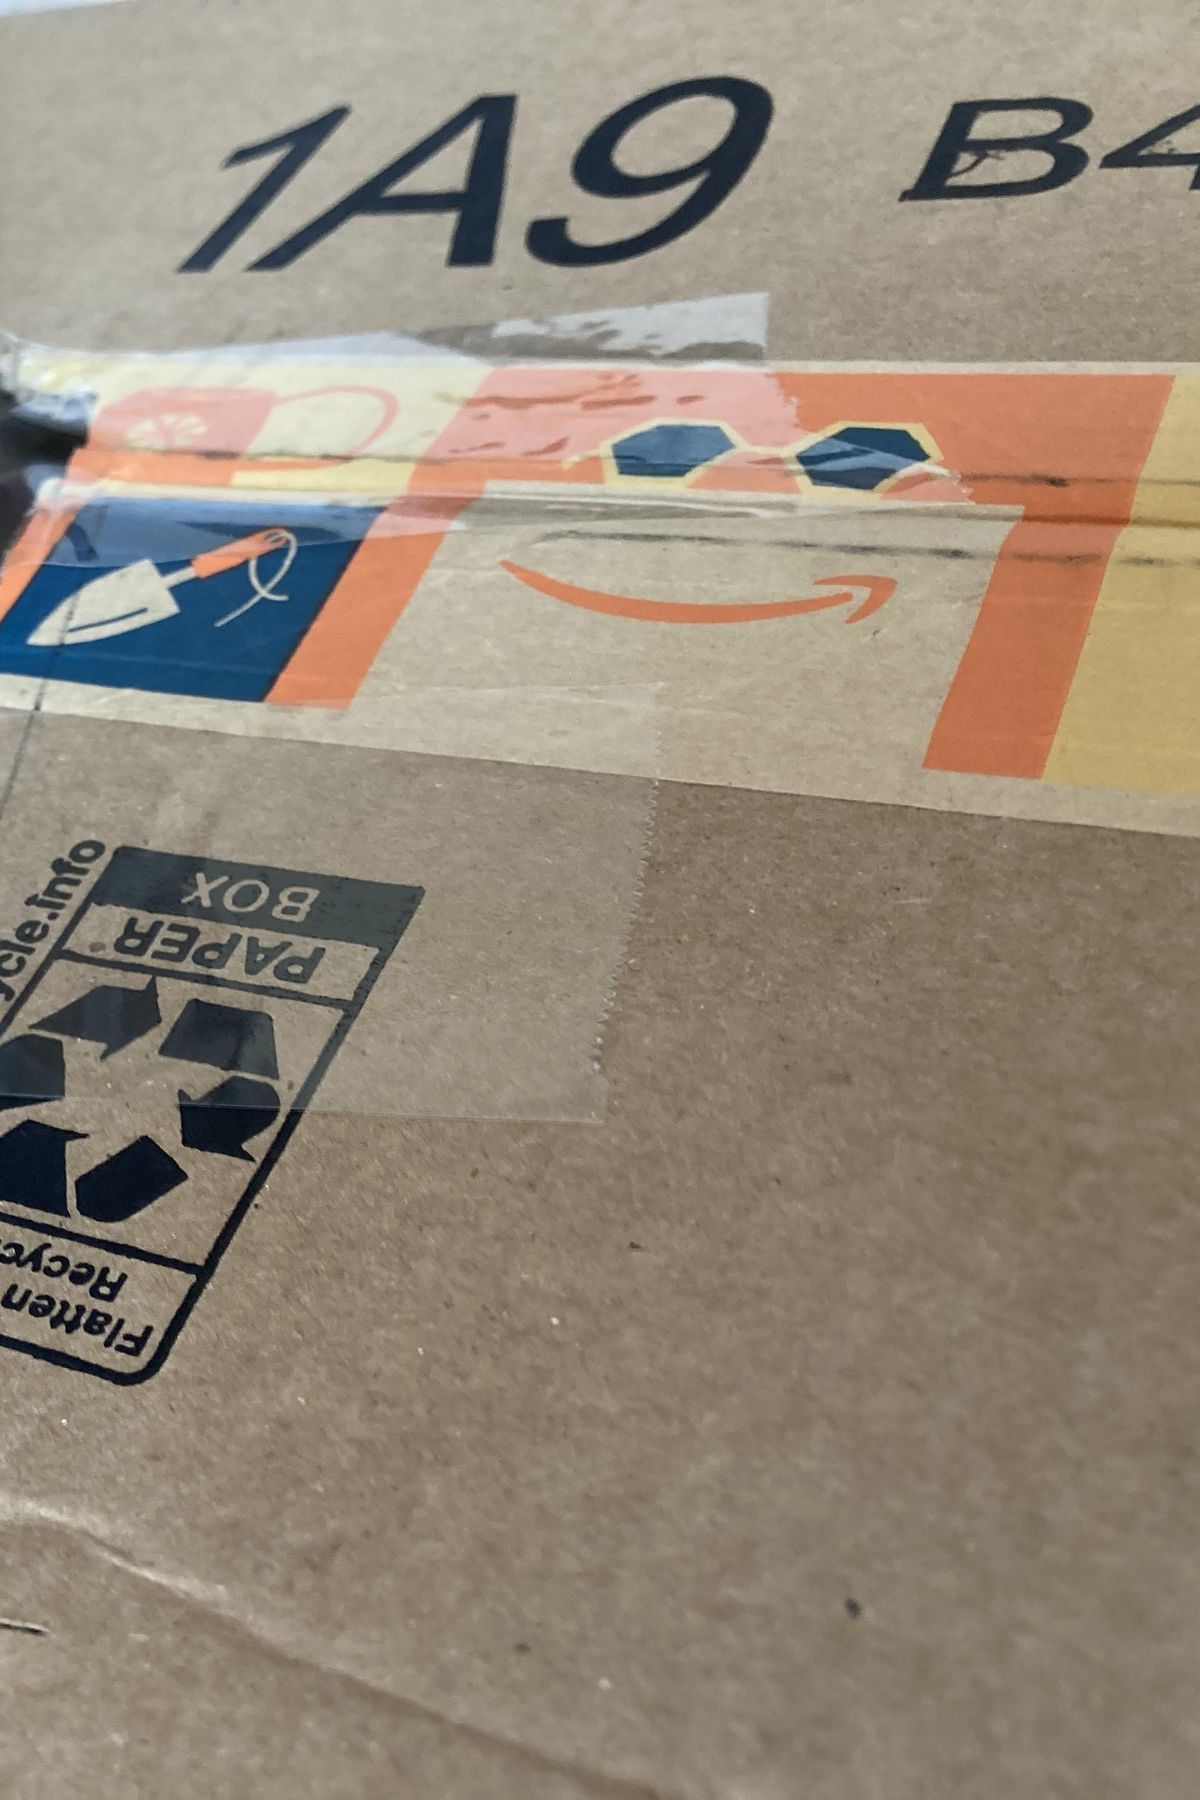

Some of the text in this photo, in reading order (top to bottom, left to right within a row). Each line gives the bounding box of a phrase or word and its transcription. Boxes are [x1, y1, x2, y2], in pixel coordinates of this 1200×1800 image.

[177, 74, 774, 273] 1A9
[181, 871, 319, 922] BOX
[114, 915, 327, 984] PAPER
[3, 1283, 154, 1358] Flatten
